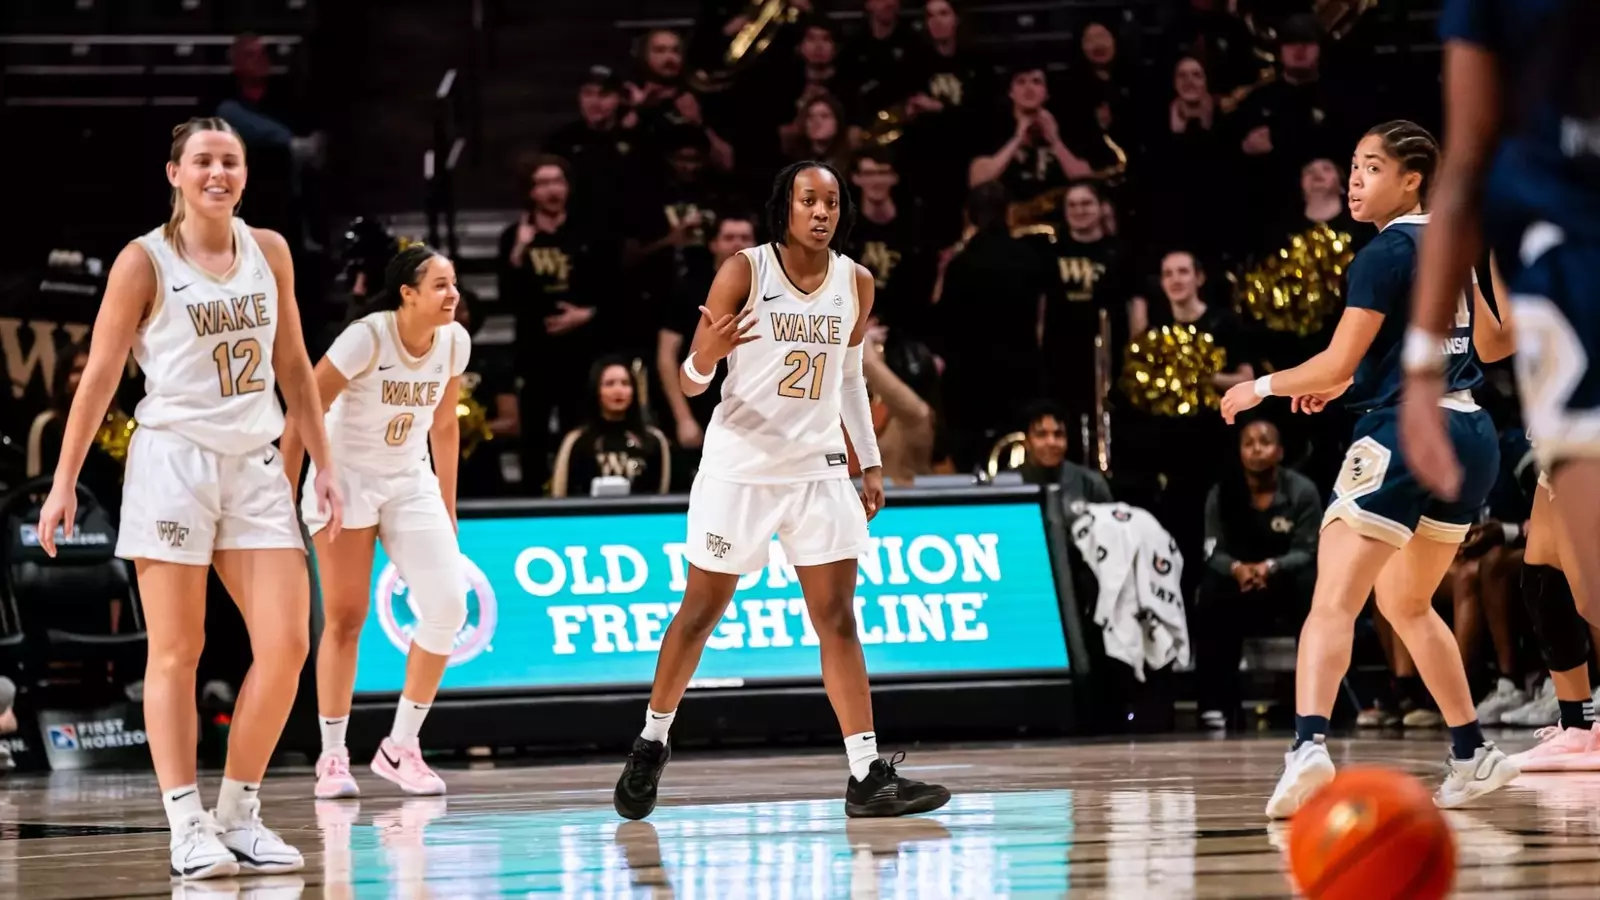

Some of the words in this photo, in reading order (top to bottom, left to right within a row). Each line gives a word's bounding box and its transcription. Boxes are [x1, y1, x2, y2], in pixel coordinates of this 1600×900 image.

[186, 293, 271, 337] WAKE
[770, 312, 842, 345] WAKE
[212, 337, 265, 397] 12
[777, 350, 827, 400] 21
[381, 380, 440, 406] WAKE
[384, 412, 415, 446] 0
[156, 520, 190, 547] WF
[706, 532, 732, 558] WF
[514, 544, 649, 597] OLD
[546, 598, 821, 655] FREGHT
[852, 592, 988, 645] LINE
[77, 718, 124, 737] FIRST
[80, 730, 146, 750] HORIZO
